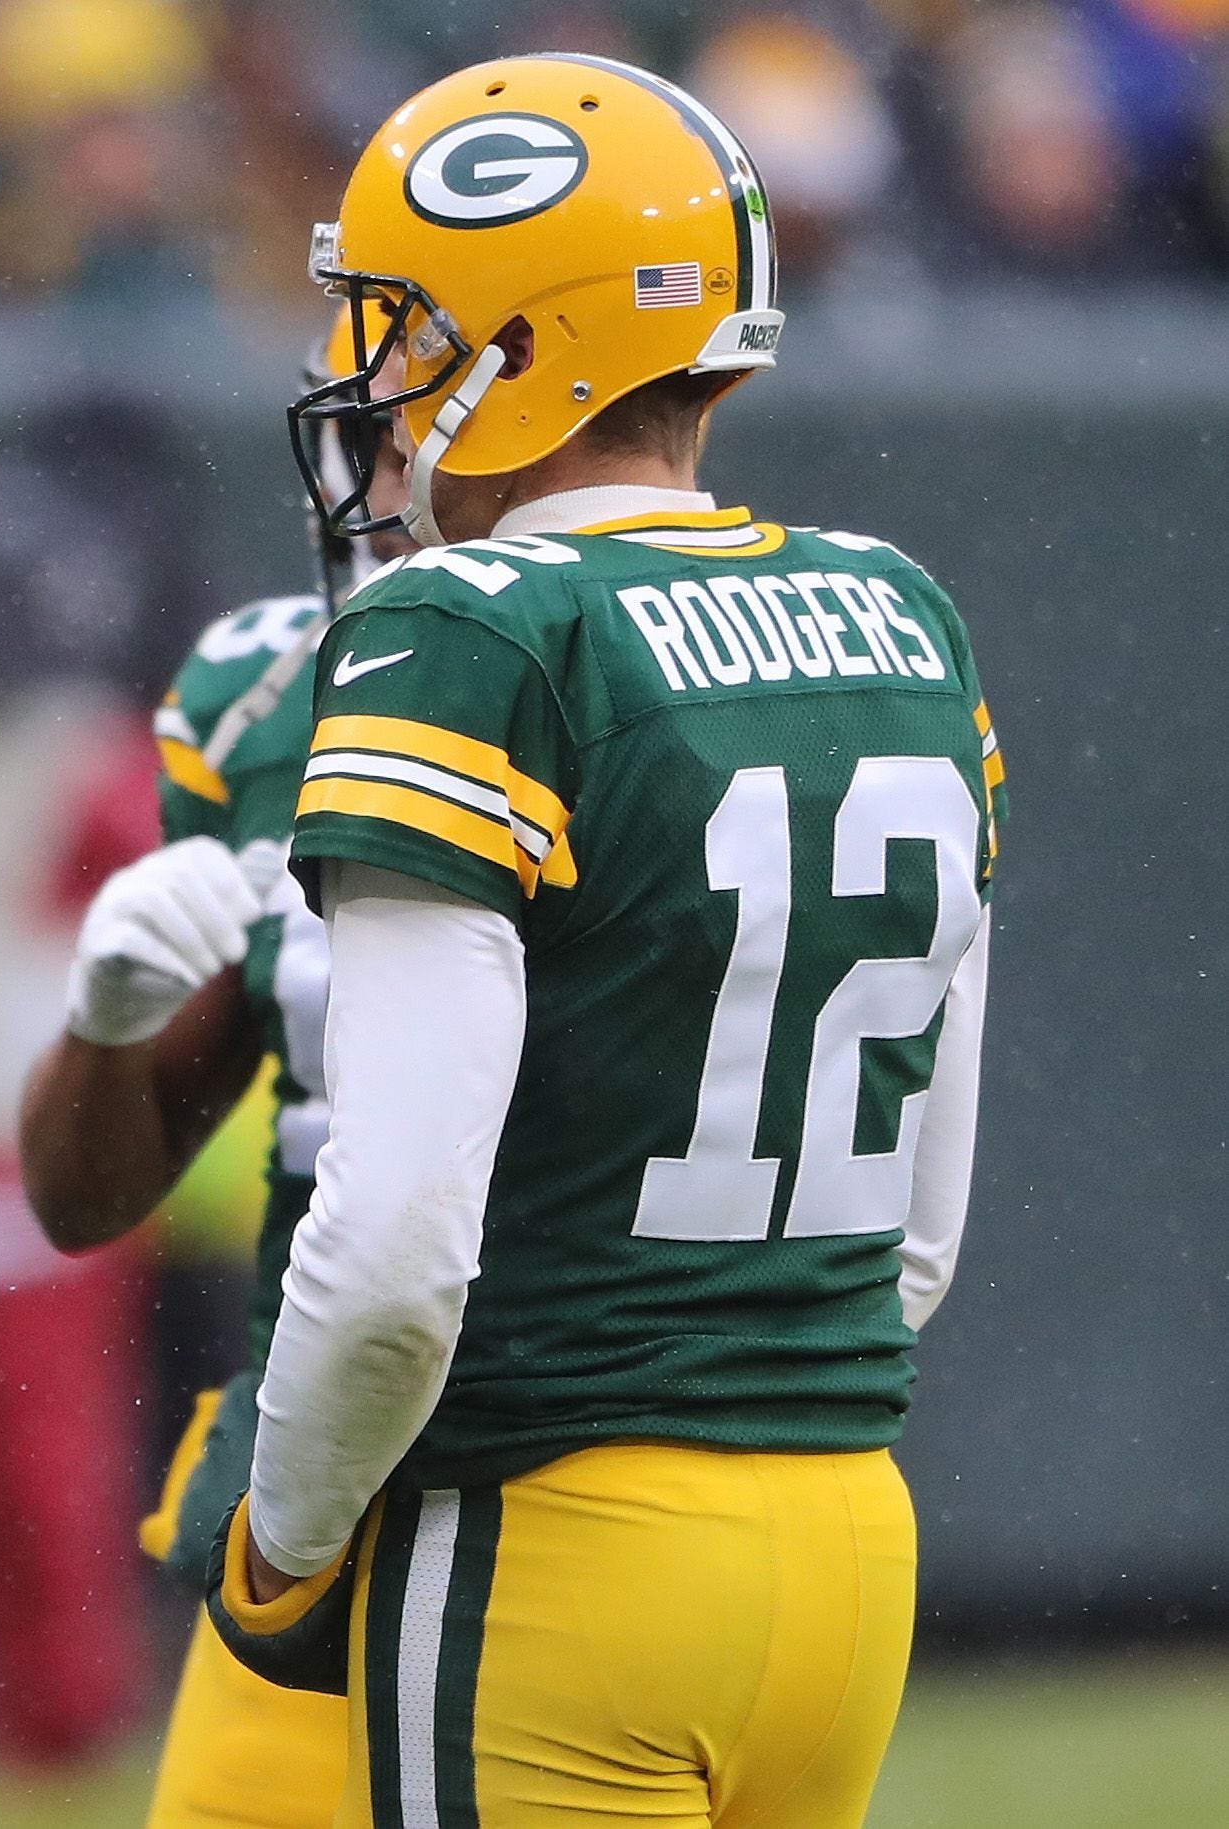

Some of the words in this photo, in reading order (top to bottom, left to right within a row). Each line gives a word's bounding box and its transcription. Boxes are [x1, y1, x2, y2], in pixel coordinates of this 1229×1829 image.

[410, 117, 579, 219] G
[617, 572, 944, 691] RODGERS
[630, 756, 981, 1241] 12
